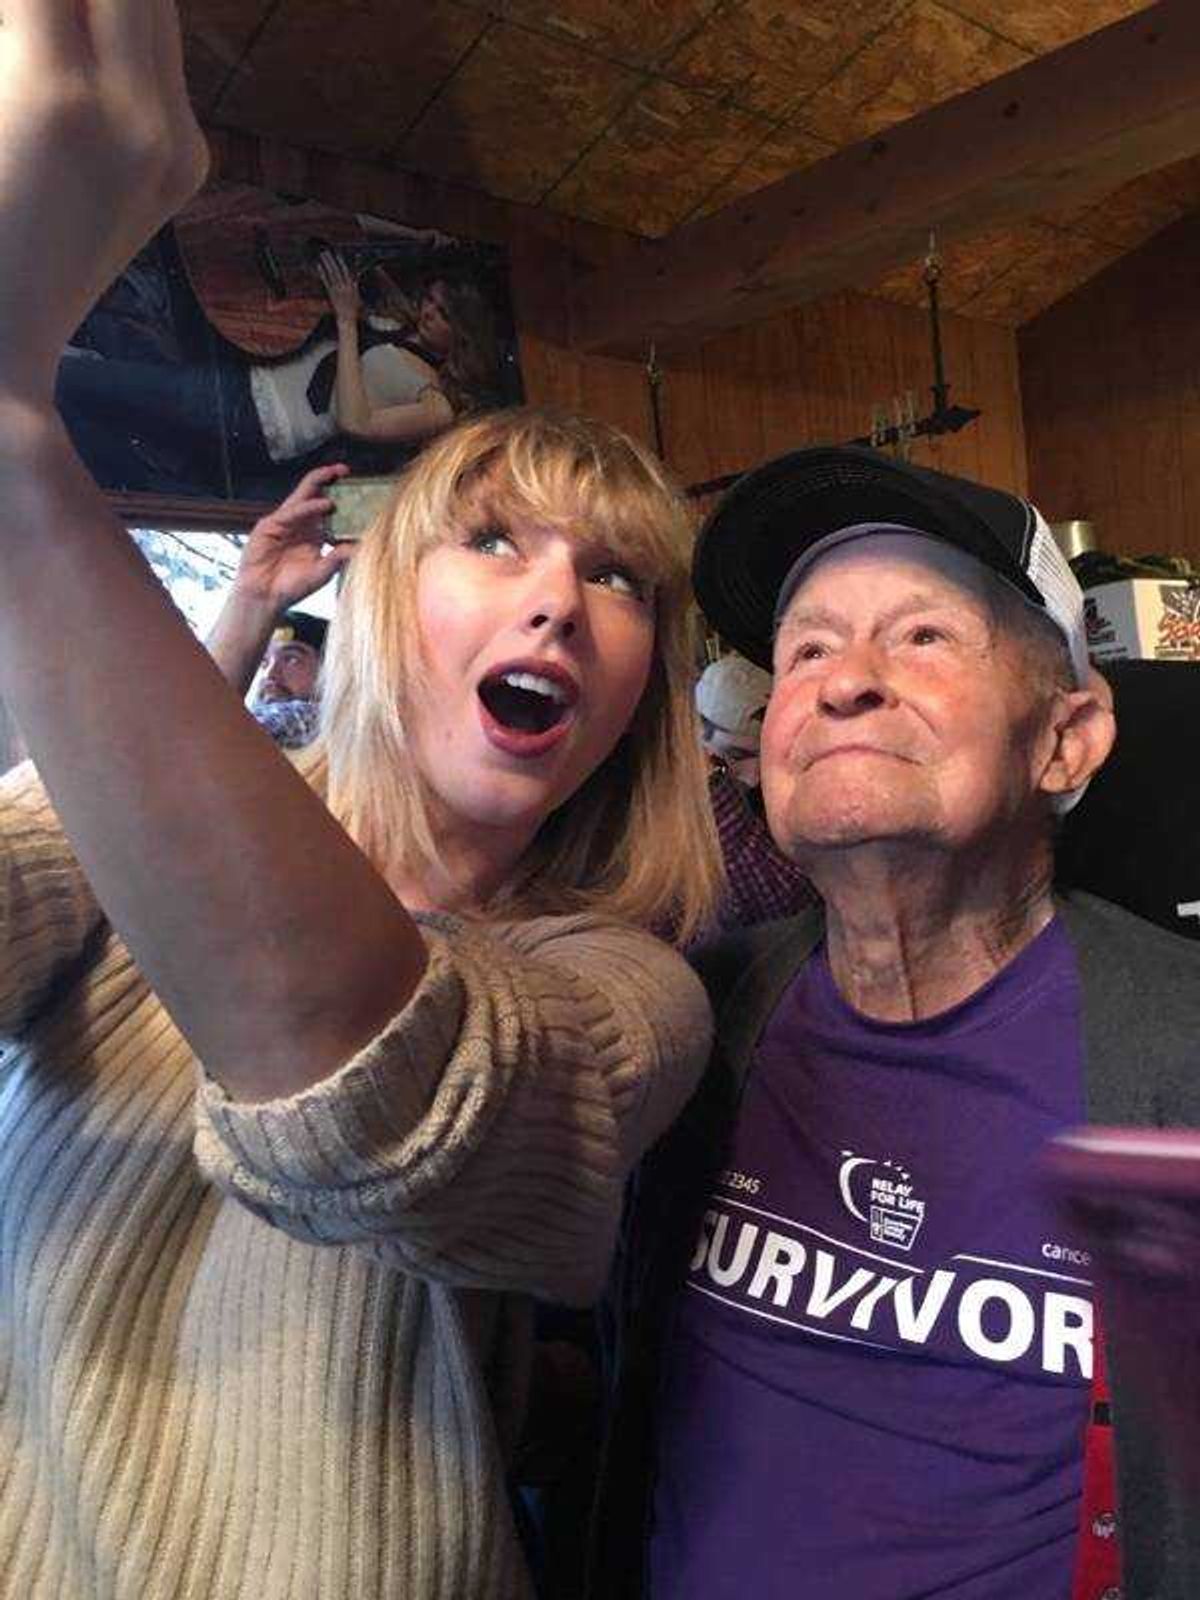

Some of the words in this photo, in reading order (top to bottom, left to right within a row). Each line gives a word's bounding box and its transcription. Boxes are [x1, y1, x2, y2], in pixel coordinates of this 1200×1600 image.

[872, 1178, 914, 1198] RELAY
[870, 1189, 896, 1207] FOR
[898, 1196, 925, 1214] LIFE
[688, 1208, 1094, 1380] SURVIVOR
